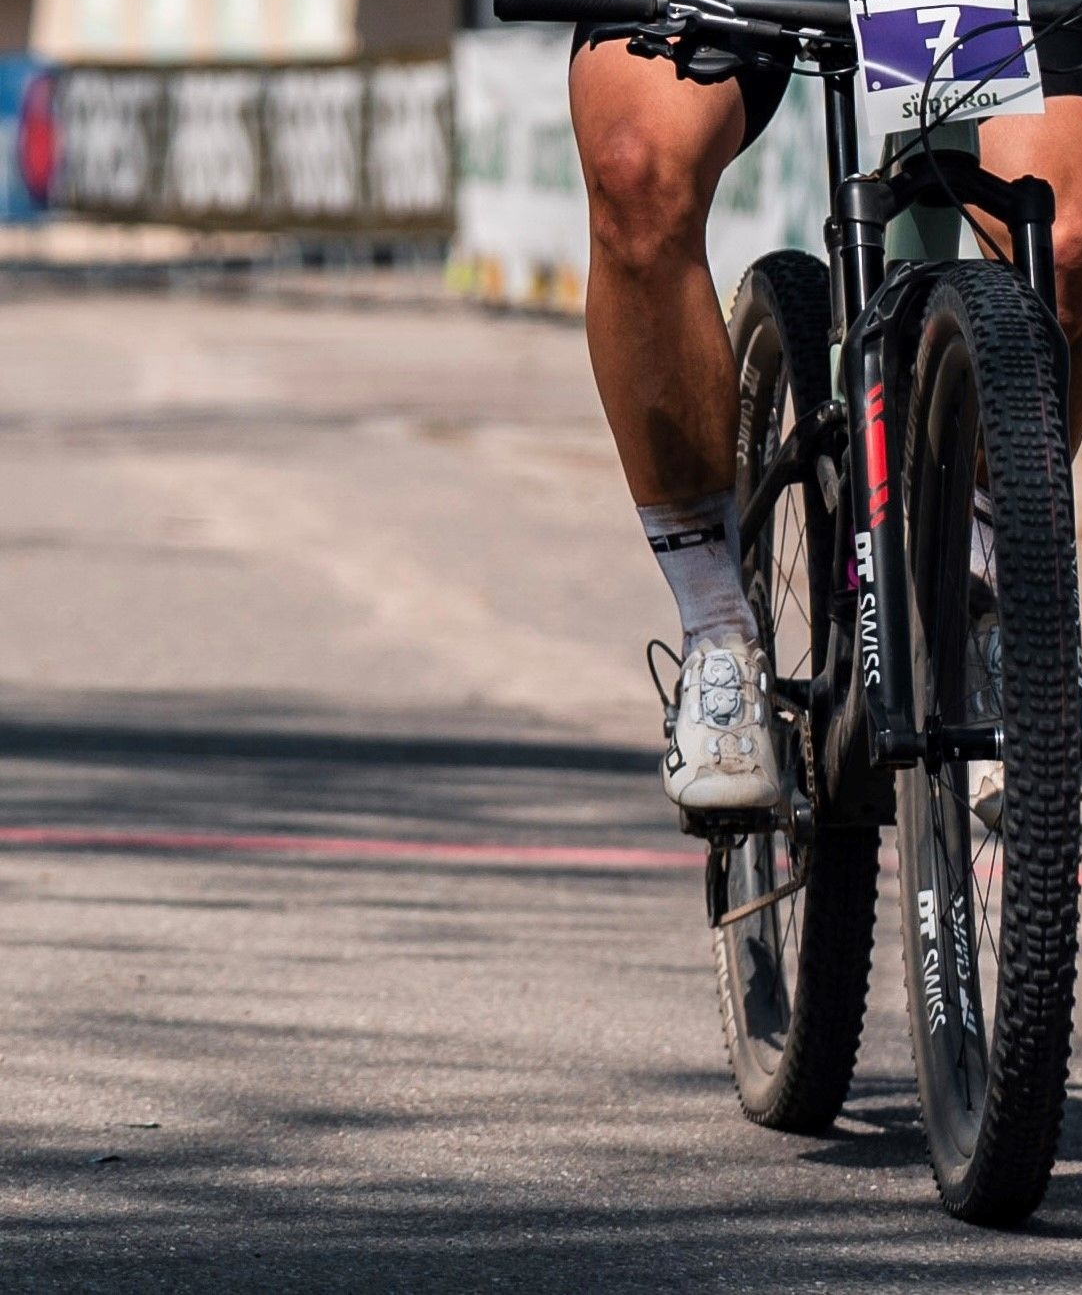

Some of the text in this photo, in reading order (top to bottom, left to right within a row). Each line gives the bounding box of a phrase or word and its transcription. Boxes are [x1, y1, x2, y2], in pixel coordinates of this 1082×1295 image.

[916, 6, 964, 79] 7
[854, 531, 881, 688] DT SWISS
[917, 889, 947, 1035] DT SWISS
